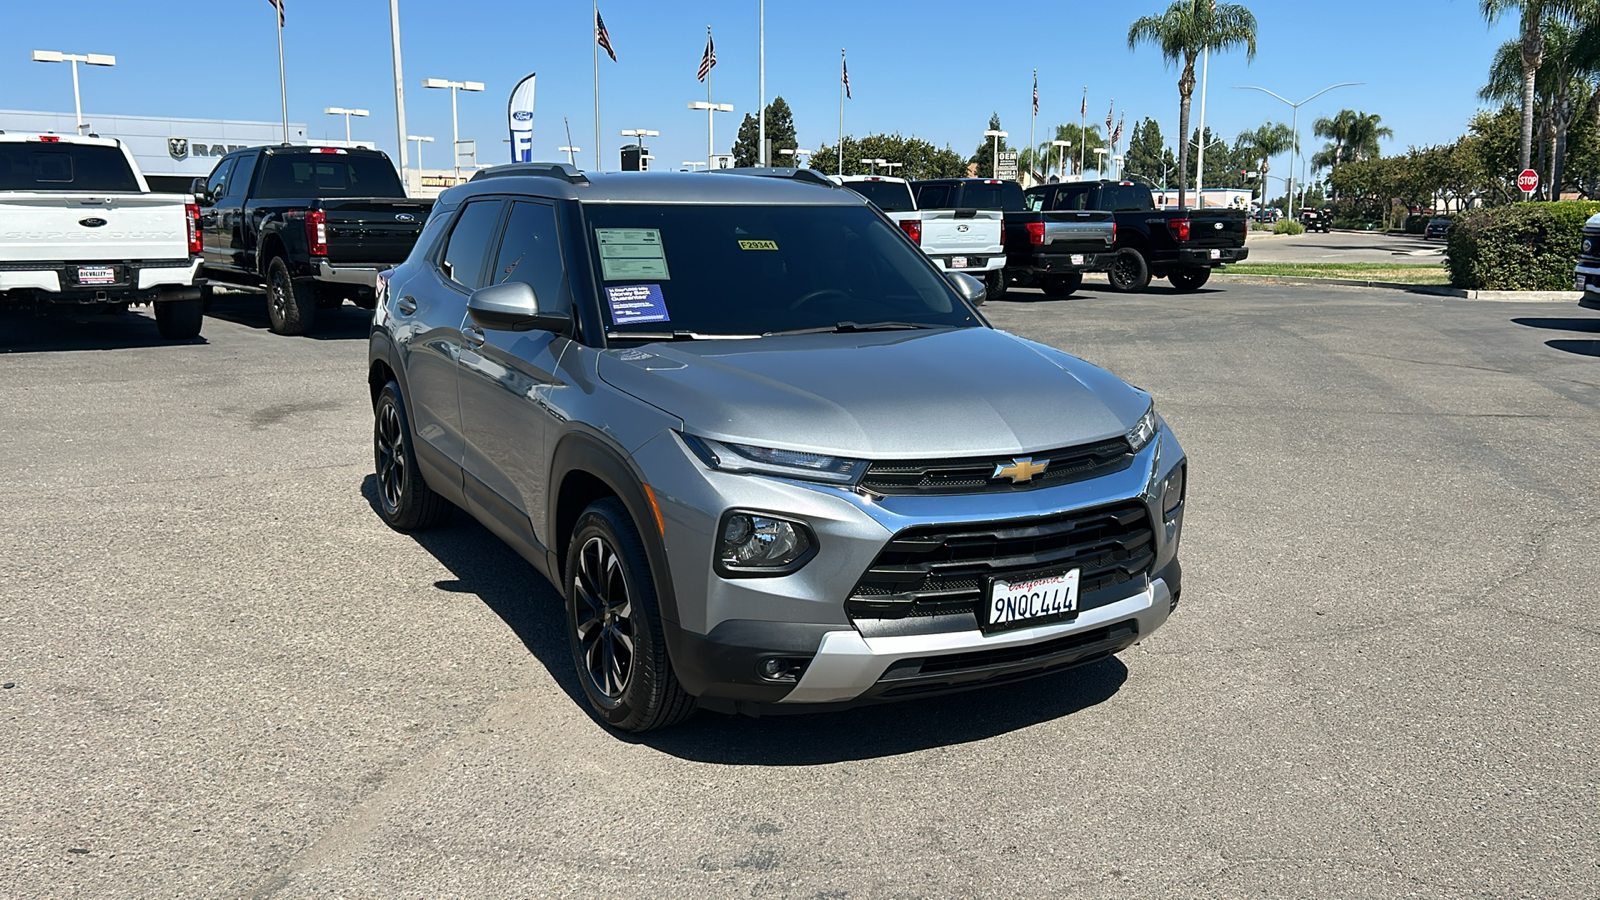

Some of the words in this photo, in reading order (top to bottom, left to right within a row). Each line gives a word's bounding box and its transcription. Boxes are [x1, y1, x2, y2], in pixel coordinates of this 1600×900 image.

[1519, 176, 1537, 185] STOP
[5, 231, 101, 240] SUPER
[109, 231, 178, 239] DUTY
[741, 241, 775, 249] F29341
[994, 586, 1072, 623] 9NQC444
